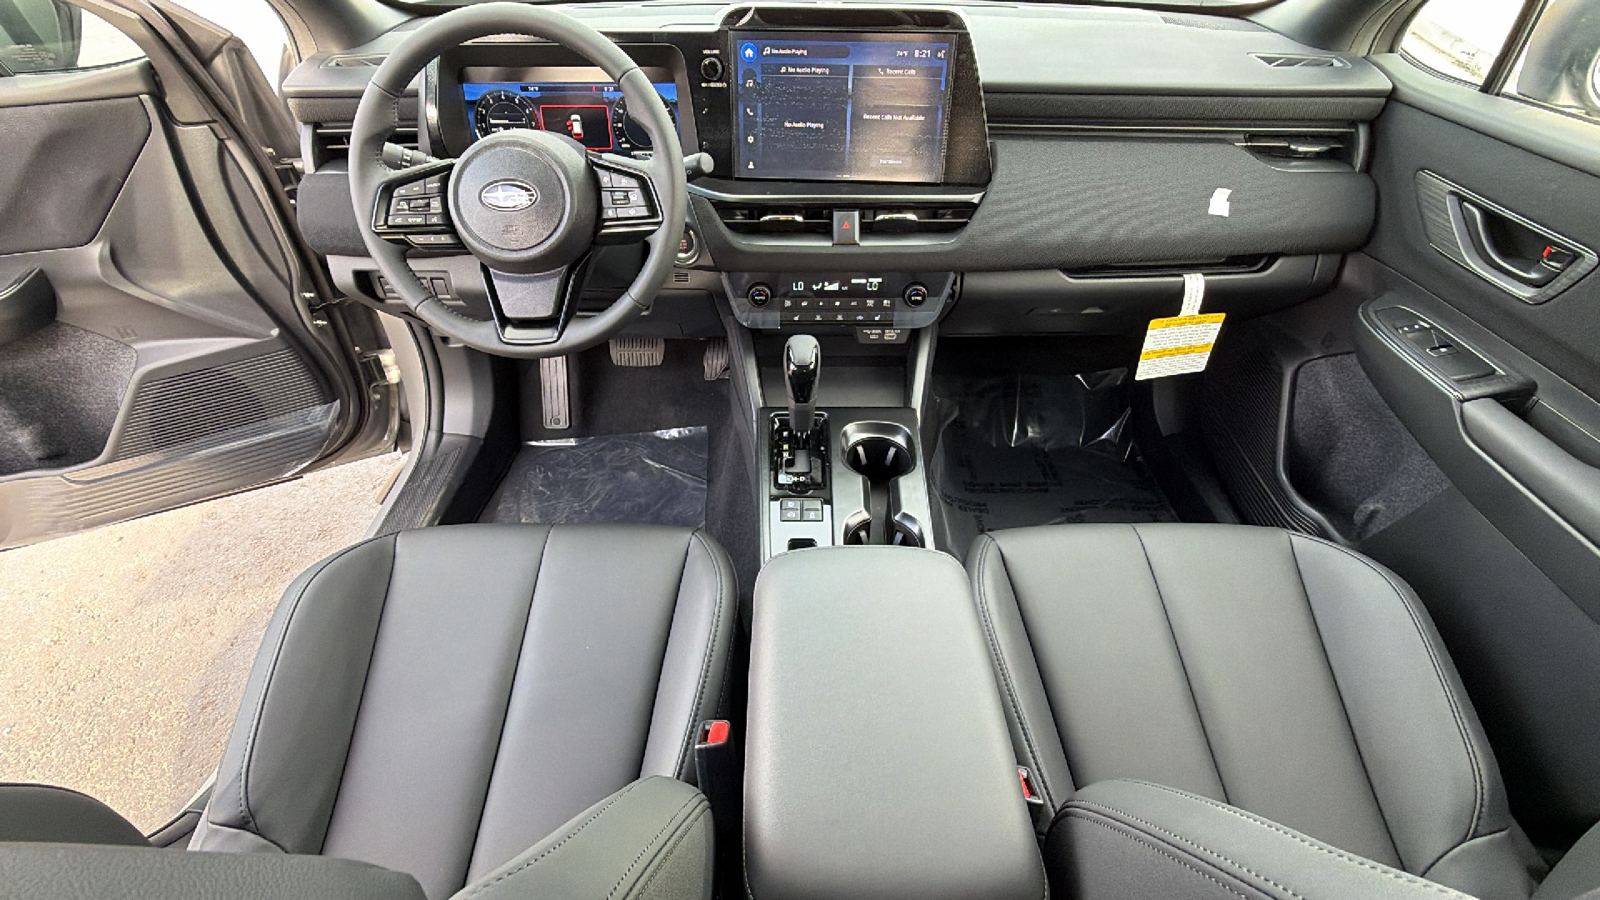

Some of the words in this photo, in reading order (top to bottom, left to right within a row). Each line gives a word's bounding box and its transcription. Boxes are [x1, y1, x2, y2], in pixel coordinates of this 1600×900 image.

[914, 49, 931, 58] 8:21
[811, 67, 830, 75] Playing
[904, 68, 917, 76] Calls
[863, 113, 881, 121] Recent
[881, 113, 893, 121] Calls
[806, 121, 824, 129] Playing
